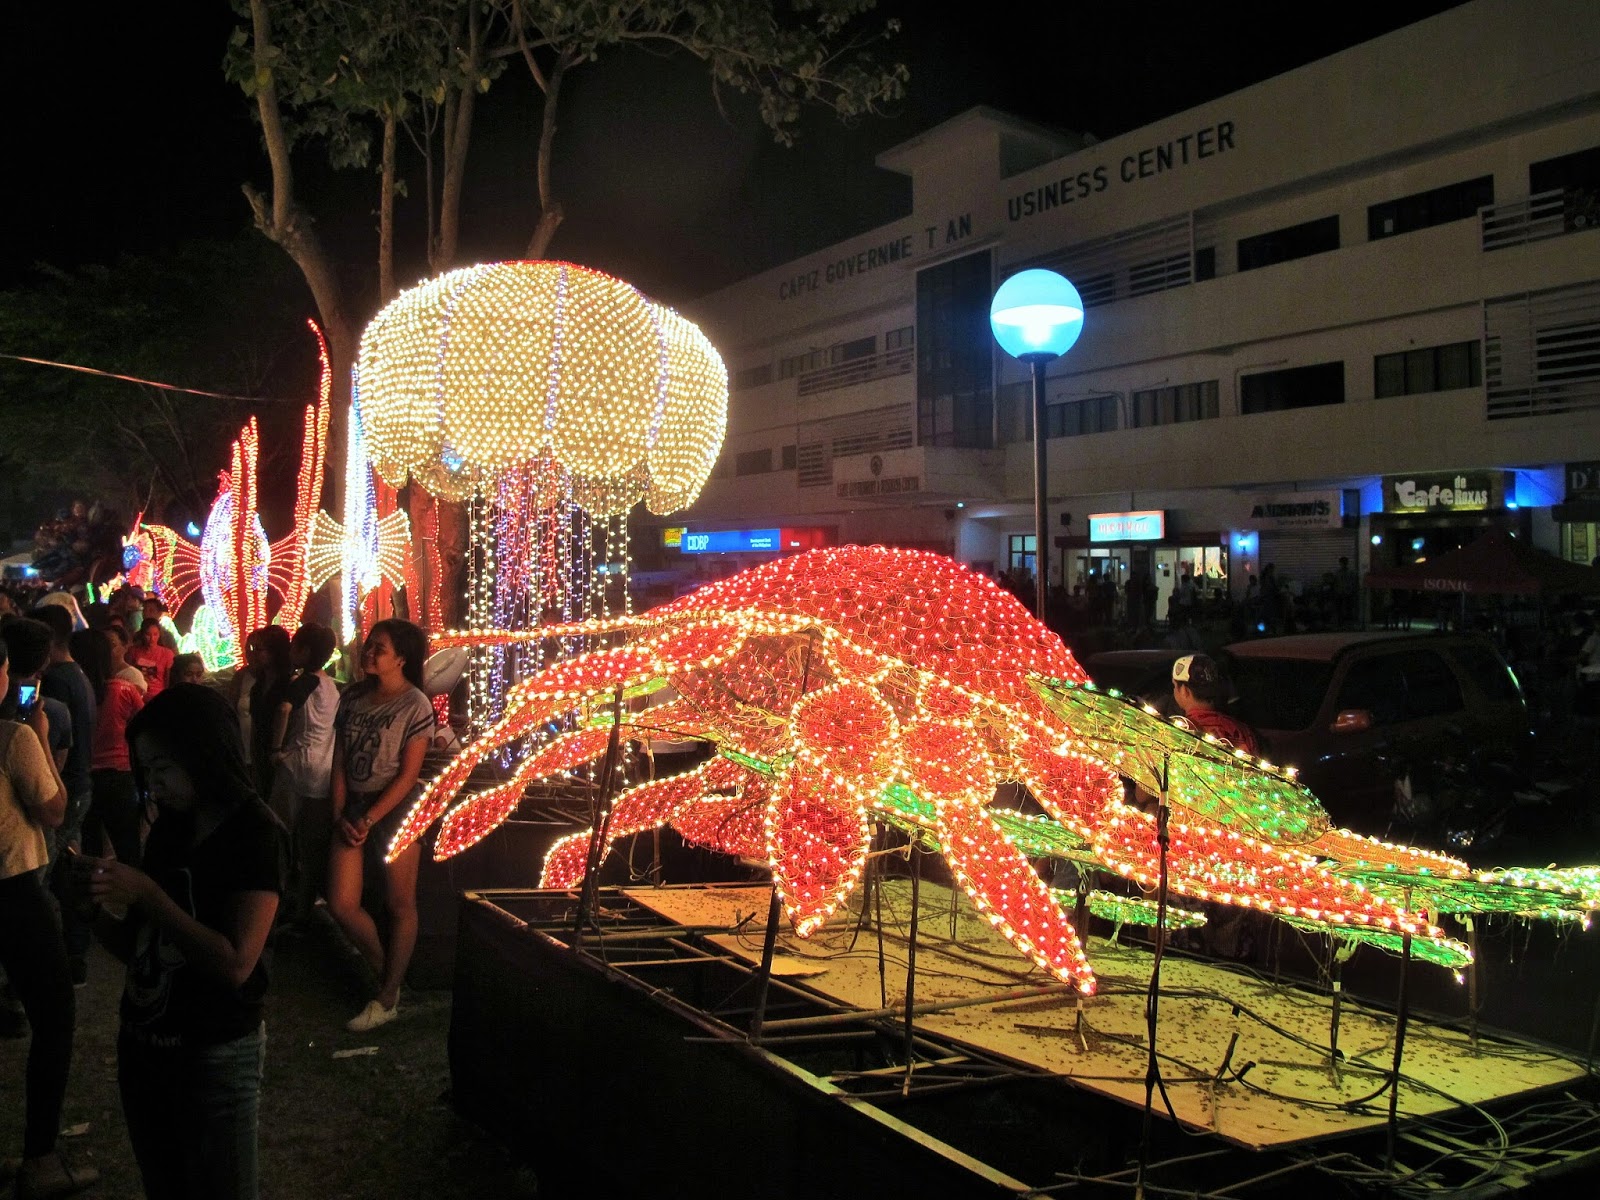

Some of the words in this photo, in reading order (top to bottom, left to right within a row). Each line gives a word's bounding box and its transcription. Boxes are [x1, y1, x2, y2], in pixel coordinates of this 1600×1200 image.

[779, 270, 820, 301] CAPIZ
[1009, 166, 1109, 221] USINESS
[1120, 121, 1236, 183] CENTER
[1454, 475, 1467, 489] de
[1395, 480, 1453, 507] Cafe
[693, 535, 709, 550] DBP
